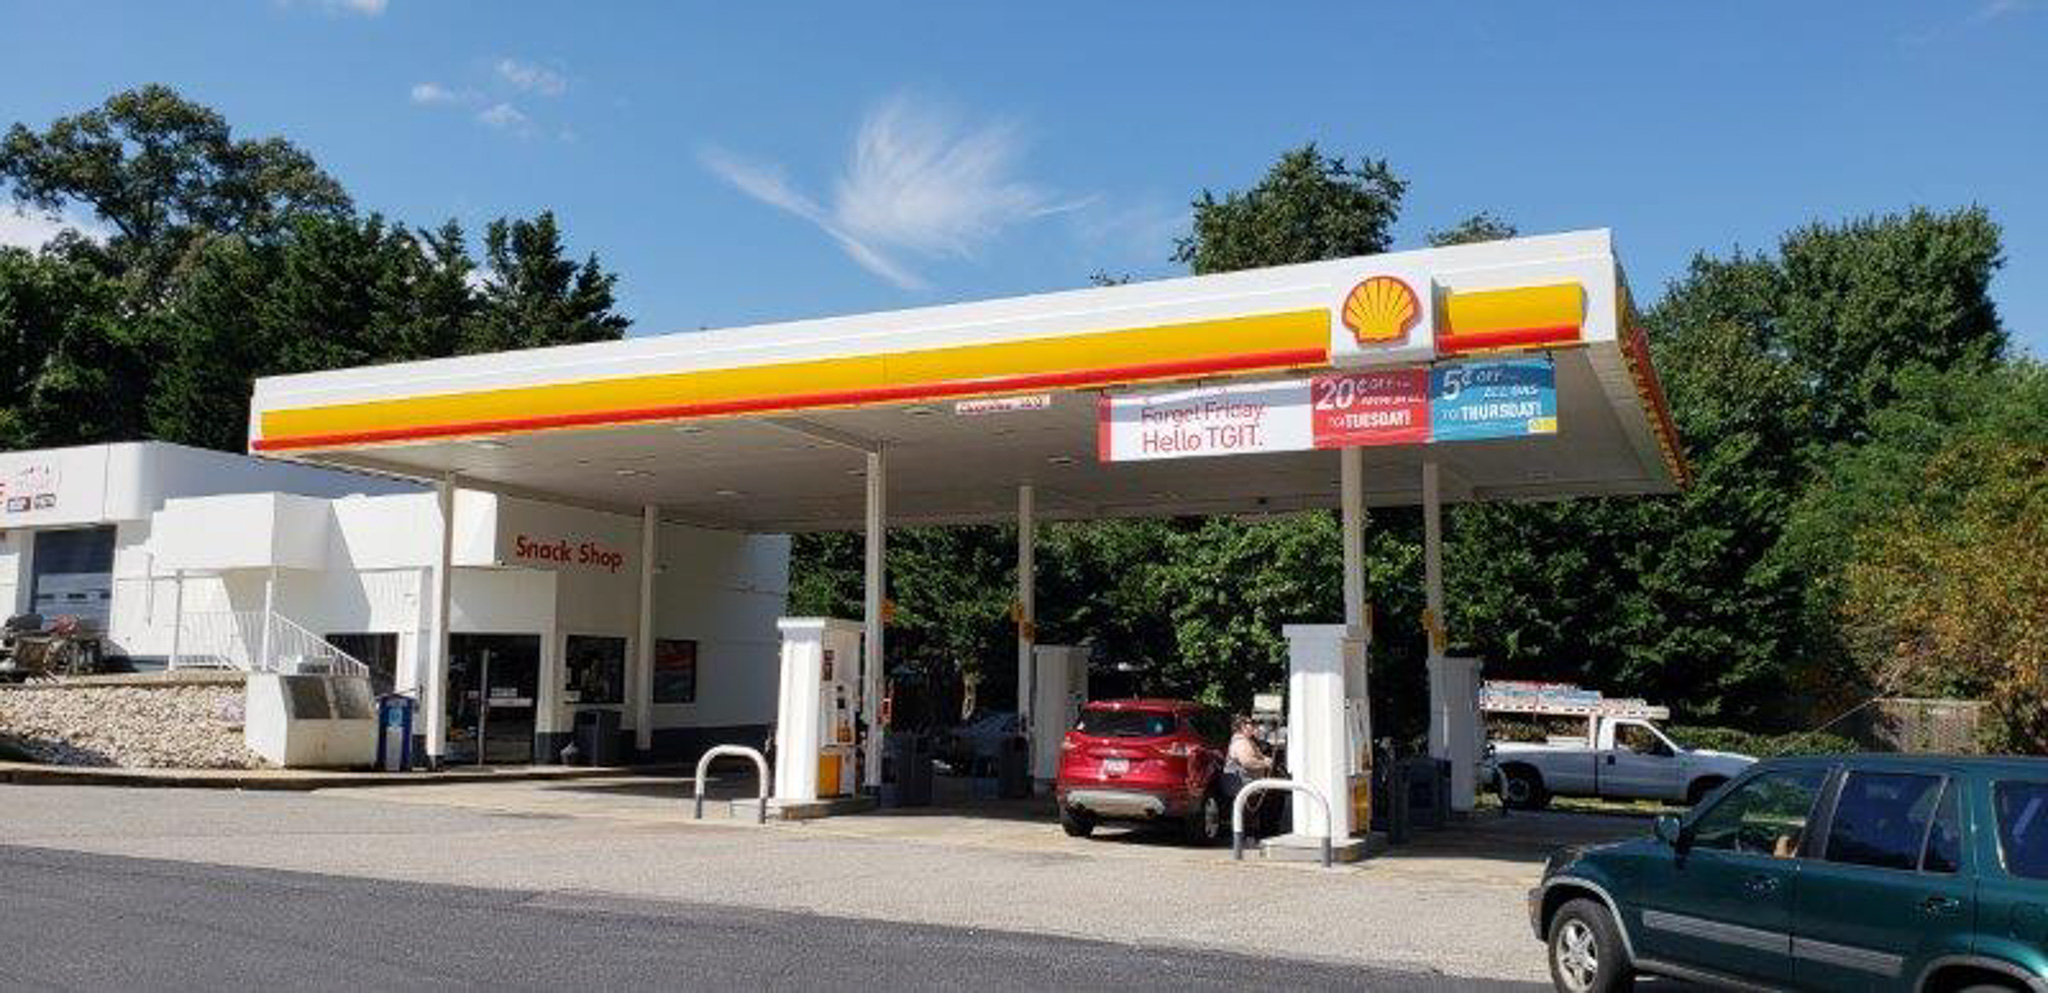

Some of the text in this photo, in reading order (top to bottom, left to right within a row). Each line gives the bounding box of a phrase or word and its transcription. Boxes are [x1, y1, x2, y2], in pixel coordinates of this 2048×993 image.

[1141, 403, 1200, 427] Forget
[1143, 424, 1264, 452] Hello TGIT.
[516, 534, 623, 573] Snack Shop
